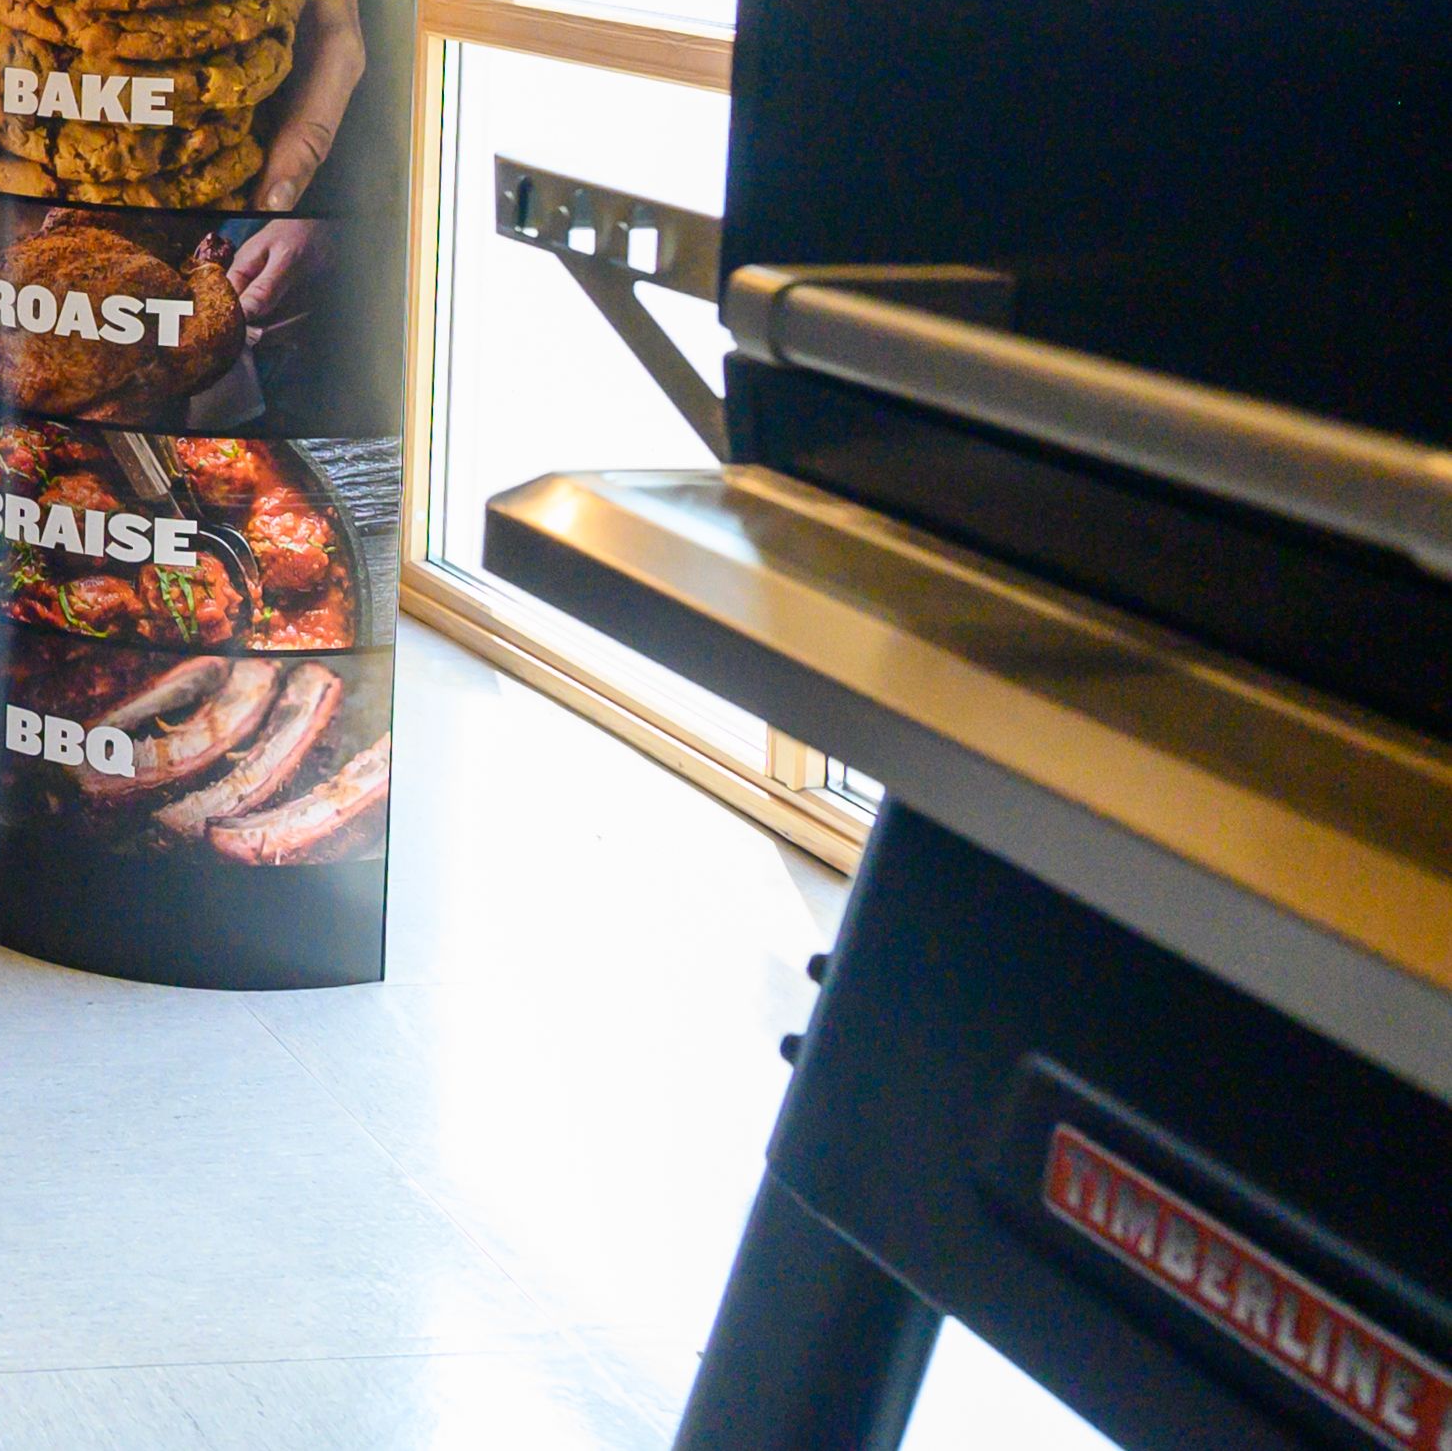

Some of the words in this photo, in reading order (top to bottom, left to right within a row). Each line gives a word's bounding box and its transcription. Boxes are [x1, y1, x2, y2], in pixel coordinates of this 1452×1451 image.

[3, 67, 175, 126] BAKE
[5, 703, 135, 778] BBQ
[1062, 1142, 1419, 1437] TIMBERLINE
